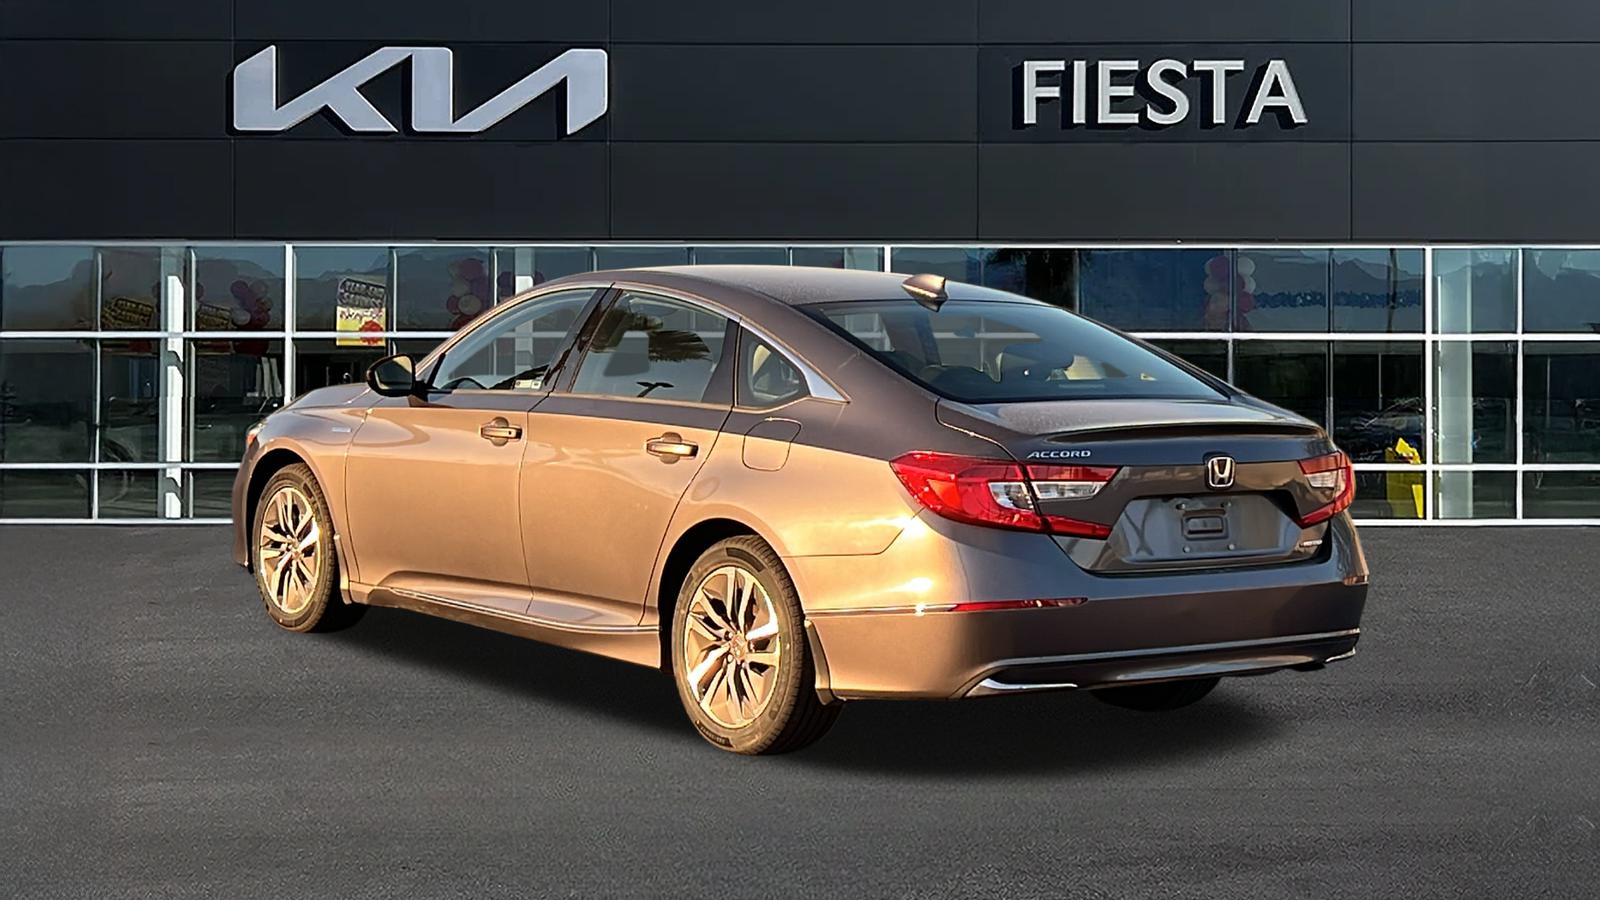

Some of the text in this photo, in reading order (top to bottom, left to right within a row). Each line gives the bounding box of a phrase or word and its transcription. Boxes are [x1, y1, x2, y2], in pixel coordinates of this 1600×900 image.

[233, 45, 608, 135] KIA
[1023, 58, 1308, 125] FIESTA
[1026, 449, 1092, 459] ACCORD
